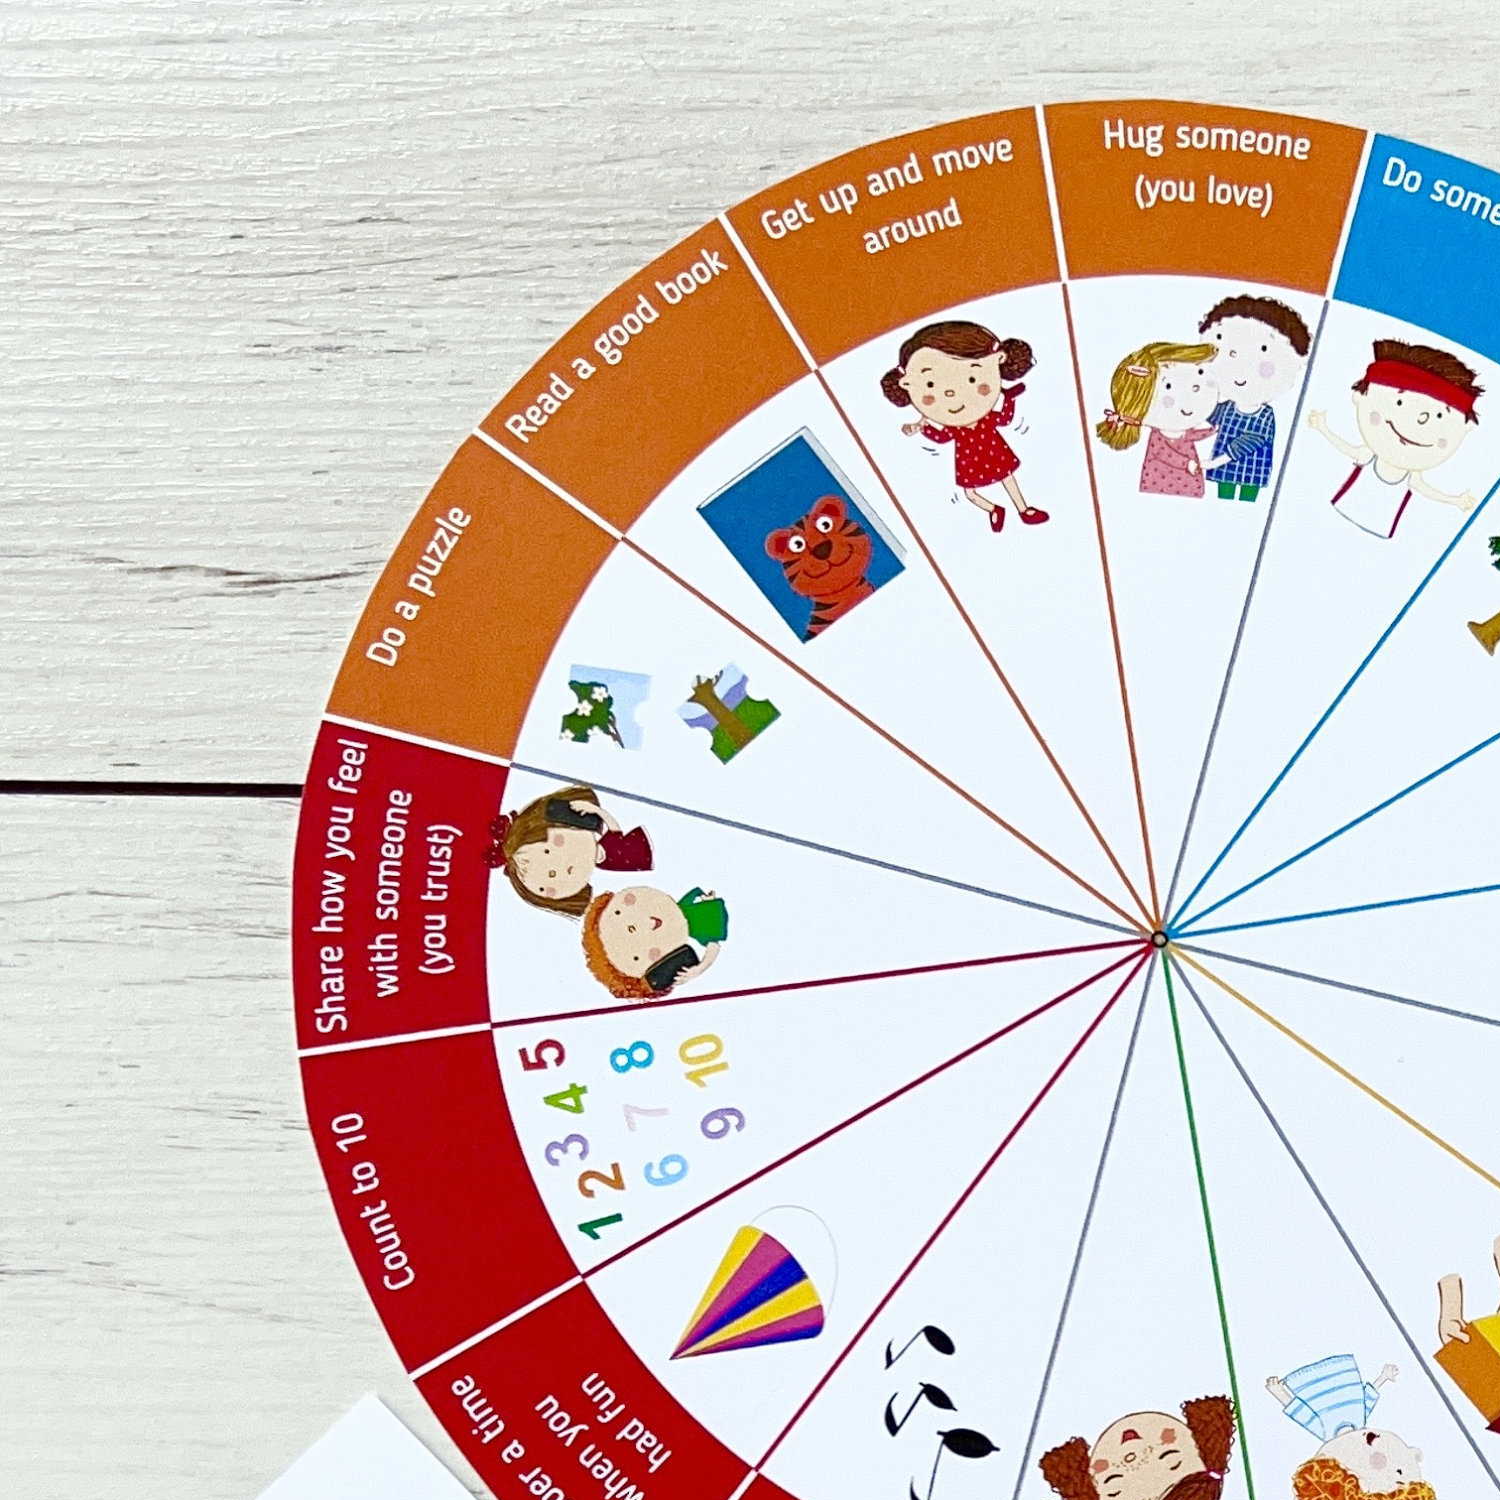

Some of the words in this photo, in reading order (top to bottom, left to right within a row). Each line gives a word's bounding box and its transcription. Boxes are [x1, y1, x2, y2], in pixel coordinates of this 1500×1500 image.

[1103, 118, 1165, 157] Hug
[1176, 125, 1311, 160] someone
[761, 198, 815, 239] Get
[819, 183, 858, 215] up
[866, 152, 924, 196] and
[931, 138, 1013, 176] move
[1135, 173, 1195, 209] (you
[1207, 174, 1273, 218] love)
[1382, 156, 1422, 193] Do
[863, 197, 962, 254] around
[504, 372, 575, 443] Read
[571, 357, 597, 380] a
[593, 293, 660, 366] good
[654, 248, 729, 305] book
[407, 507, 472, 597] puzzle
[394, 600, 421, 621] a
[365, 627, 406, 667] Do
[327, 738, 369, 794] feel
[325, 806, 356, 861] you
[375, 789, 413, 921] someone
[425, 823, 464, 901] trust)
[311, 870, 346, 933] how
[367, 933, 399, 998] with
[418, 913, 456, 974] (you
[313, 945, 348, 1033] Share
[518, 1039, 565, 1071] 5
[610, 1040, 654, 1073] 8
[678, 1033, 729, 1088] 10
[542, 1082, 589, 1114] 4
[623, 1104, 670, 1132] 7
[330, 1112, 364, 1153] 10
[701, 1107, 746, 1139] 9
[545, 1134, 589, 1167] 3
[644, 1153, 688, 1186] 6
[352, 1161, 380, 1195] to
[578, 1163, 626, 1198] 2
[359, 1199, 415, 1290] Count
[577, 1212, 624, 1242] 1
[451, 1375, 505, 1444] time
[534, 1394, 590, 1443] you
[581, 1372, 626, 1423] fun
[501, 1439, 525, 1464] a
[615, 1417, 672, 1473] had
